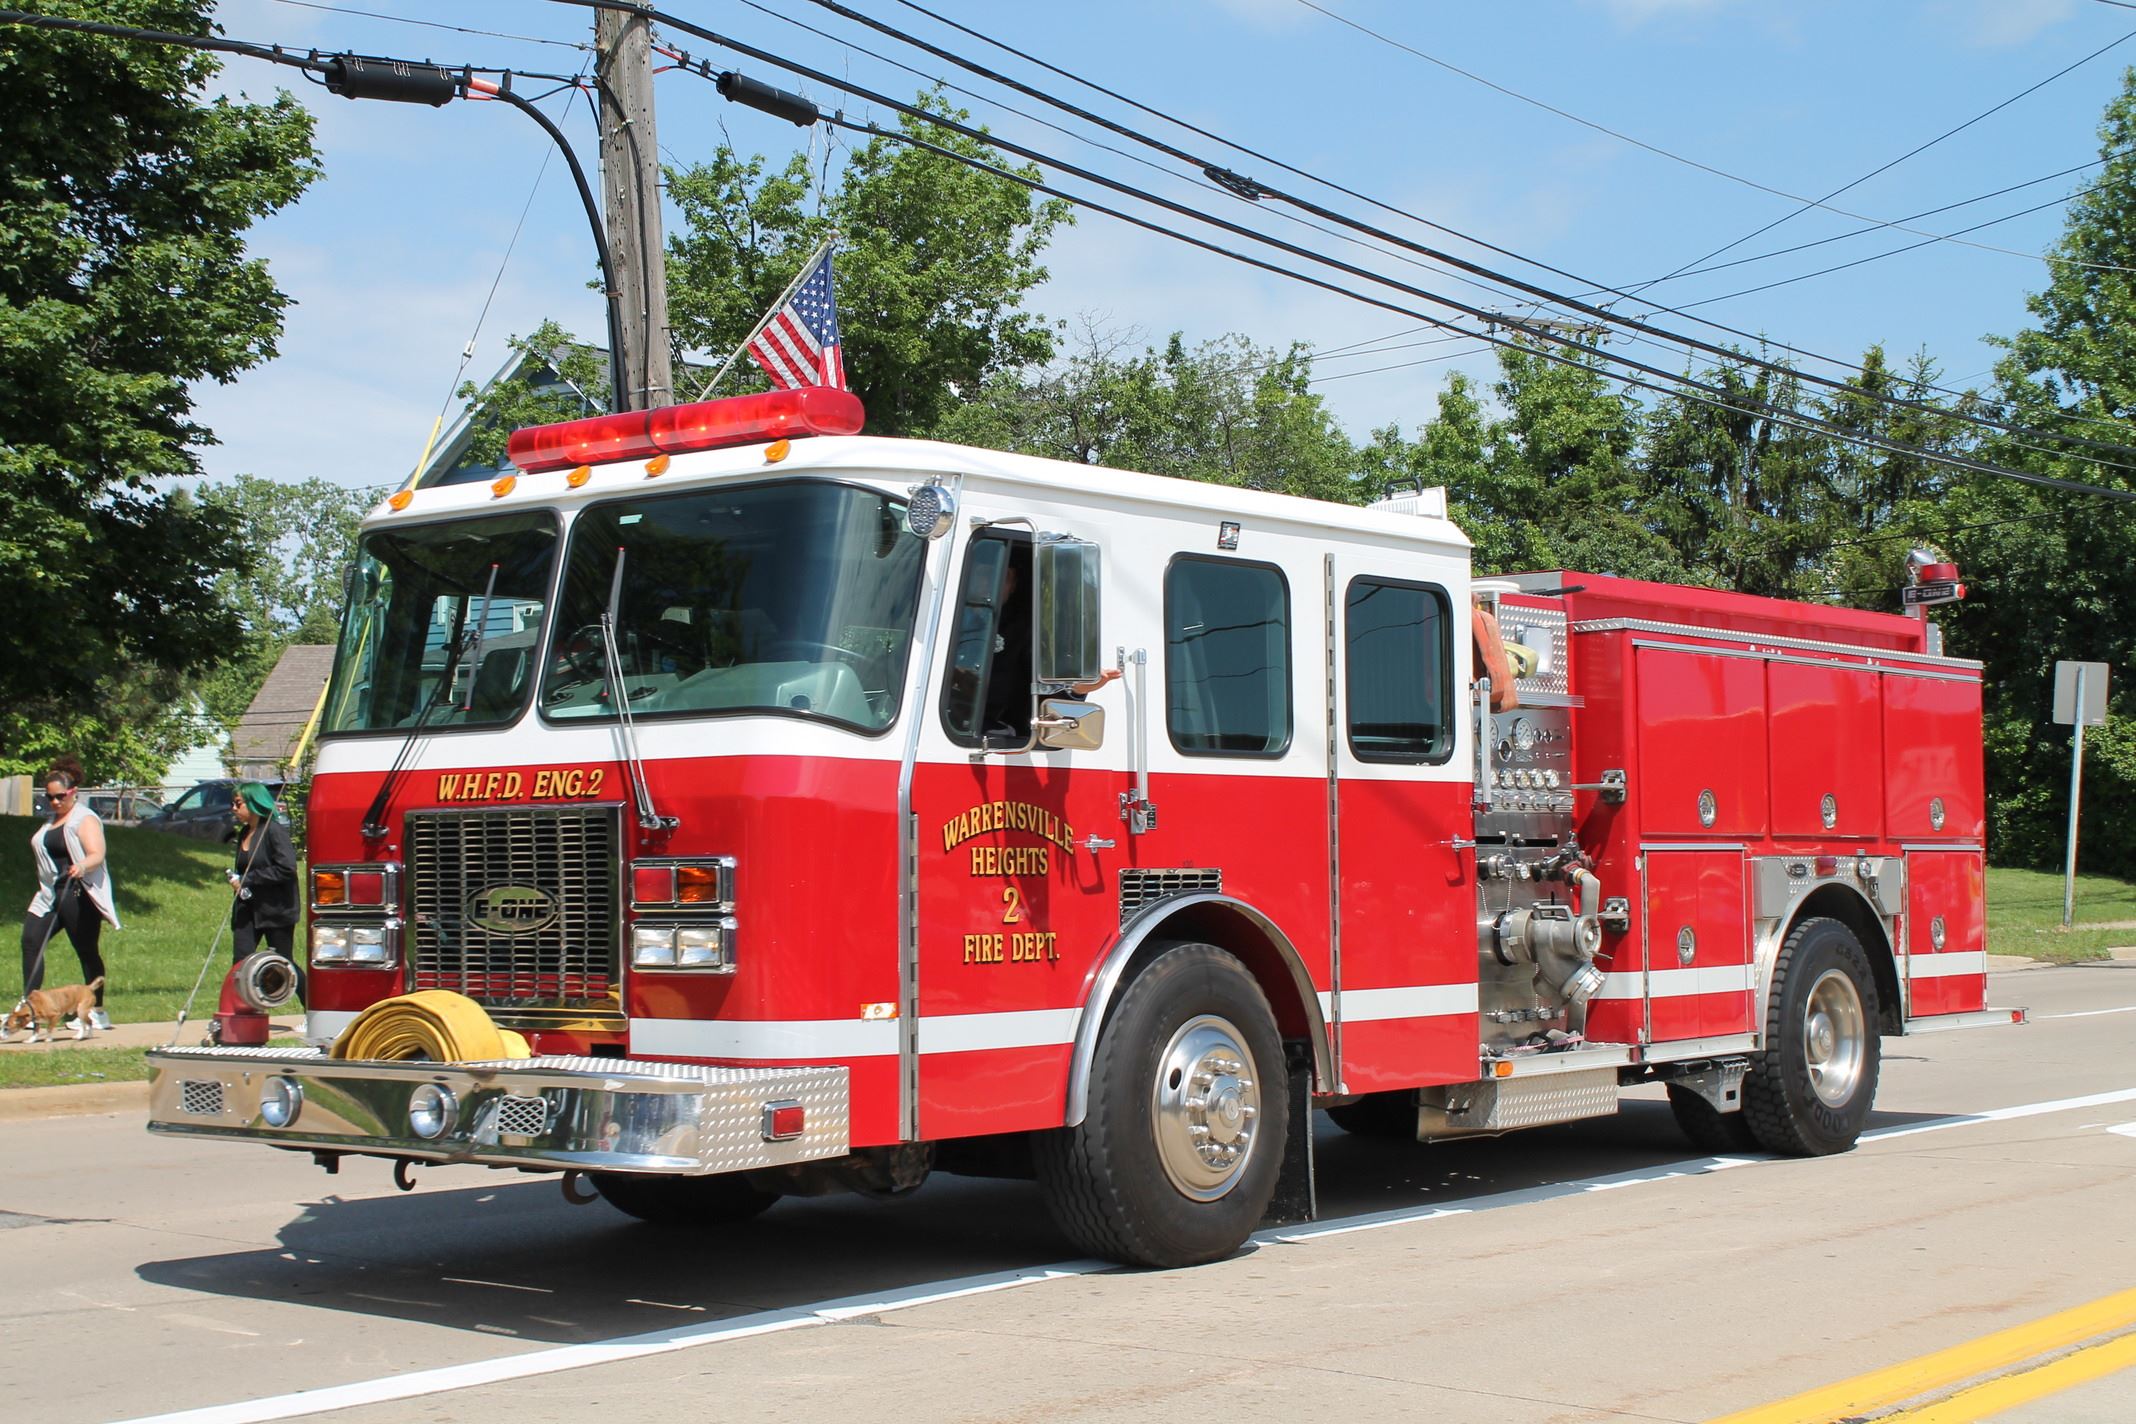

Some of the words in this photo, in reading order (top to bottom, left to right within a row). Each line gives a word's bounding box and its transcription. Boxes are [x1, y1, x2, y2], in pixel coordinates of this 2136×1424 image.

[437, 772, 524, 801] W.H.F.D.
[531, 768, 605, 799] ENG.2
[943, 800, 1074, 855] WARRENSVILLE
[970, 846, 1048, 876] HEIGHTS
[474, 898, 550, 919] E-ONE
[1003, 886, 1020, 924] 2
[963, 934, 1004, 963] FIRE
[1010, 932, 1060, 962] DEPT.
